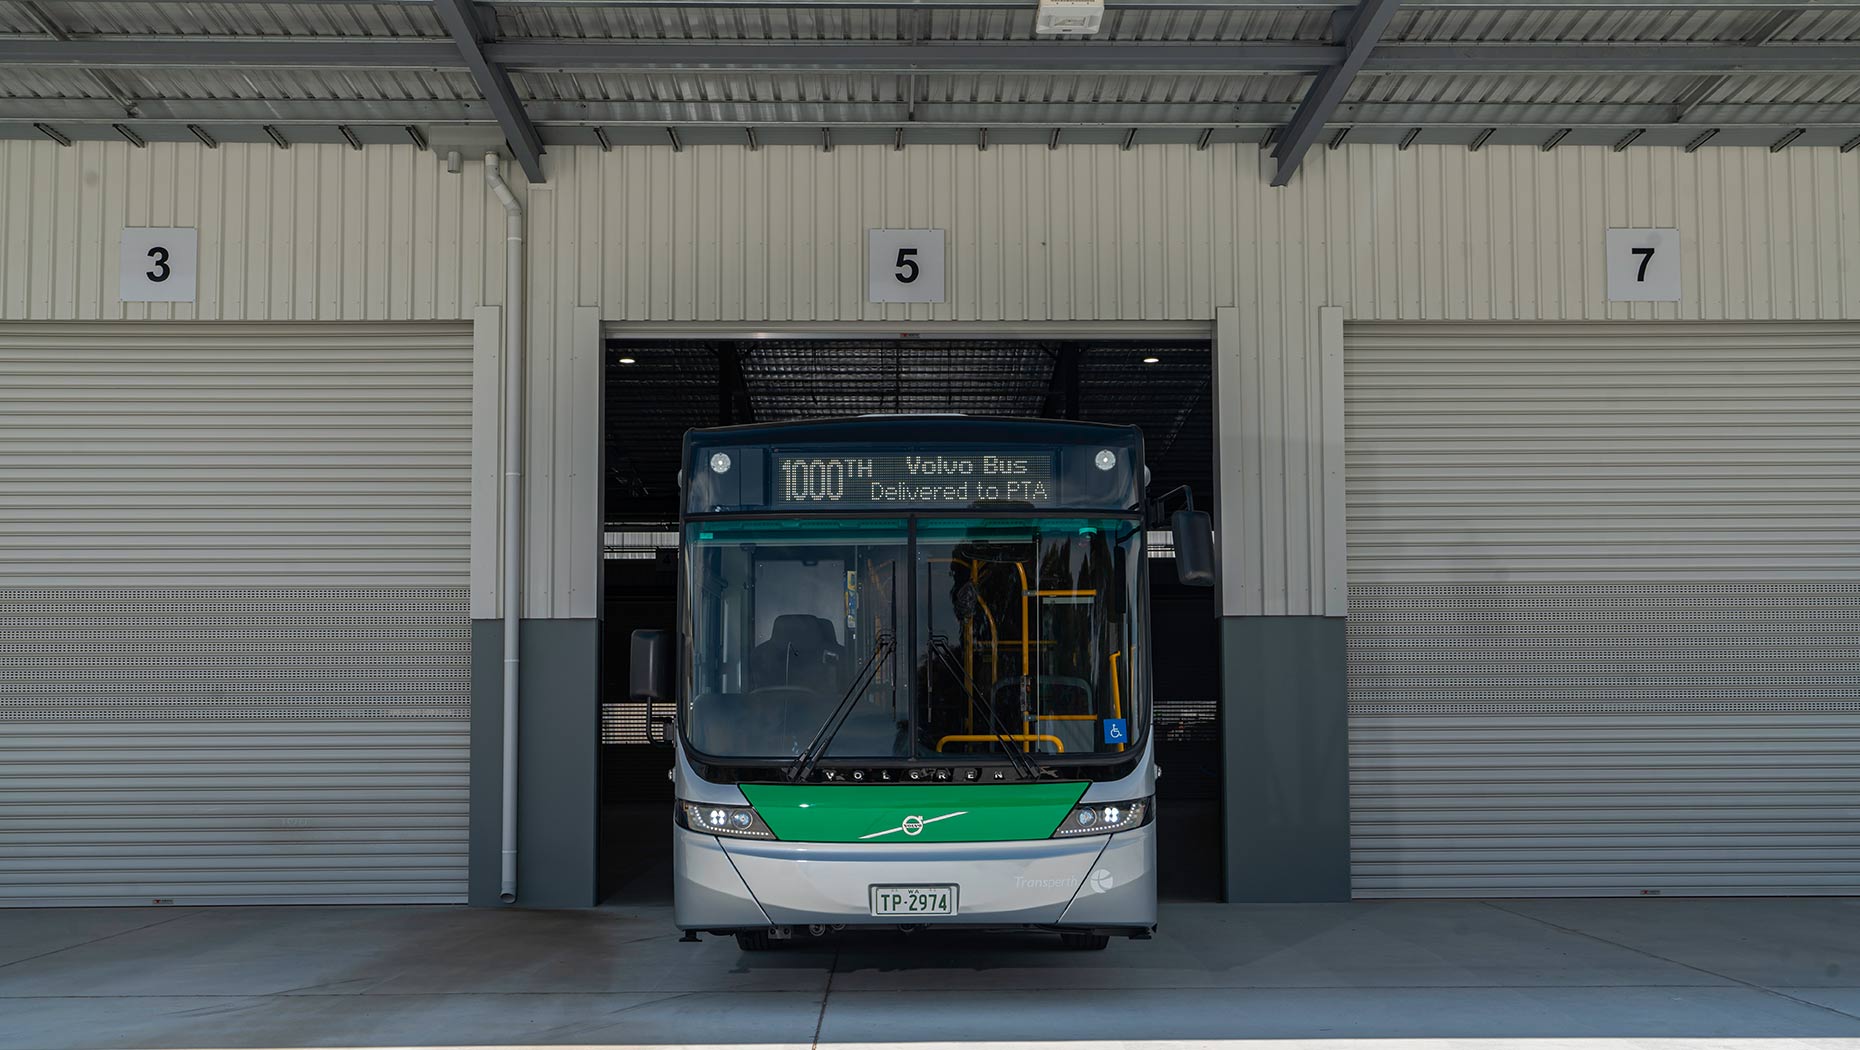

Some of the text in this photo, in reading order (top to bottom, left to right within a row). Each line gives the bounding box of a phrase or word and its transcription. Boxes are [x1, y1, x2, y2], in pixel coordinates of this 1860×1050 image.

[146, 246, 171, 282] 3
[895, 248, 919, 284] 5
[1631, 247, 1655, 282] 7
[906, 455, 1028, 475] Volvo Bus
[871, 480, 1048, 501] Delivered to PTA
[825, 771, 1003, 781] VOLGREN
[1014, 875, 1078, 892] Transperth
